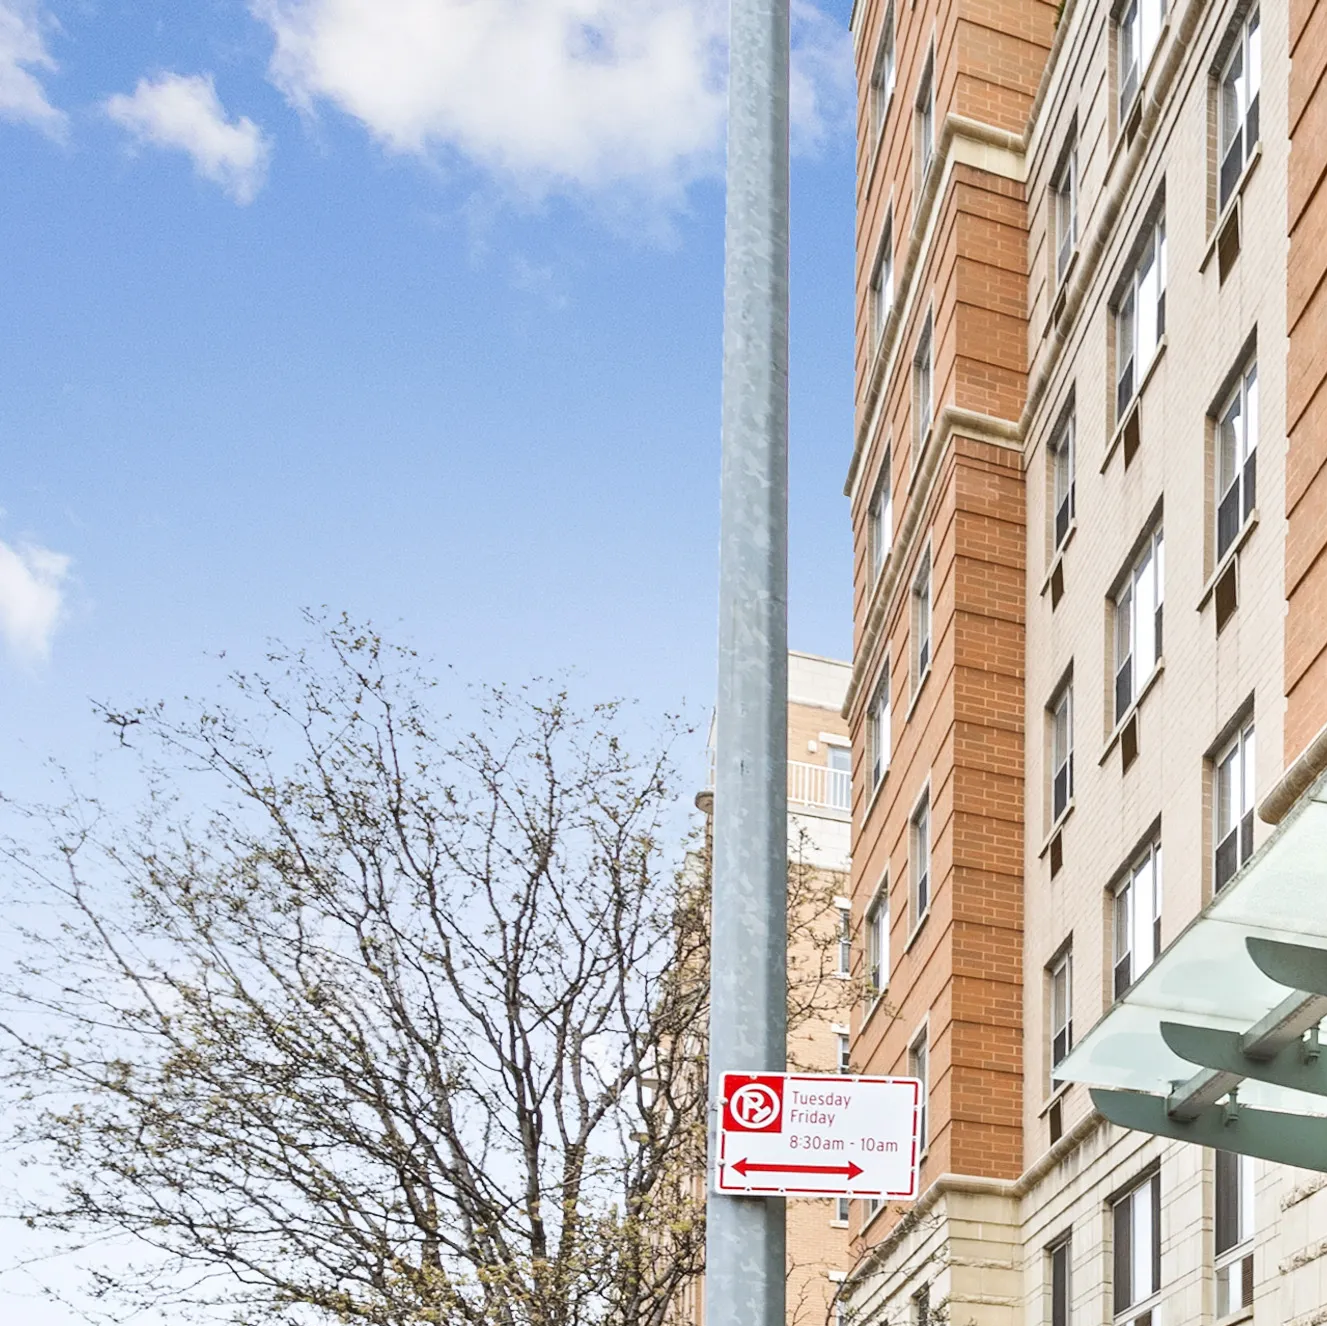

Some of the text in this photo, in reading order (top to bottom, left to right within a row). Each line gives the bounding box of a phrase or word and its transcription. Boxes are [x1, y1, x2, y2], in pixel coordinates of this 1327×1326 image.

[792, 1091, 851, 1109] Tuesday
[790, 1110, 836, 1127] Friday
[789, 1135, 844, 1151] 8:30am
[861, 1138, 898, 1152] 10am
